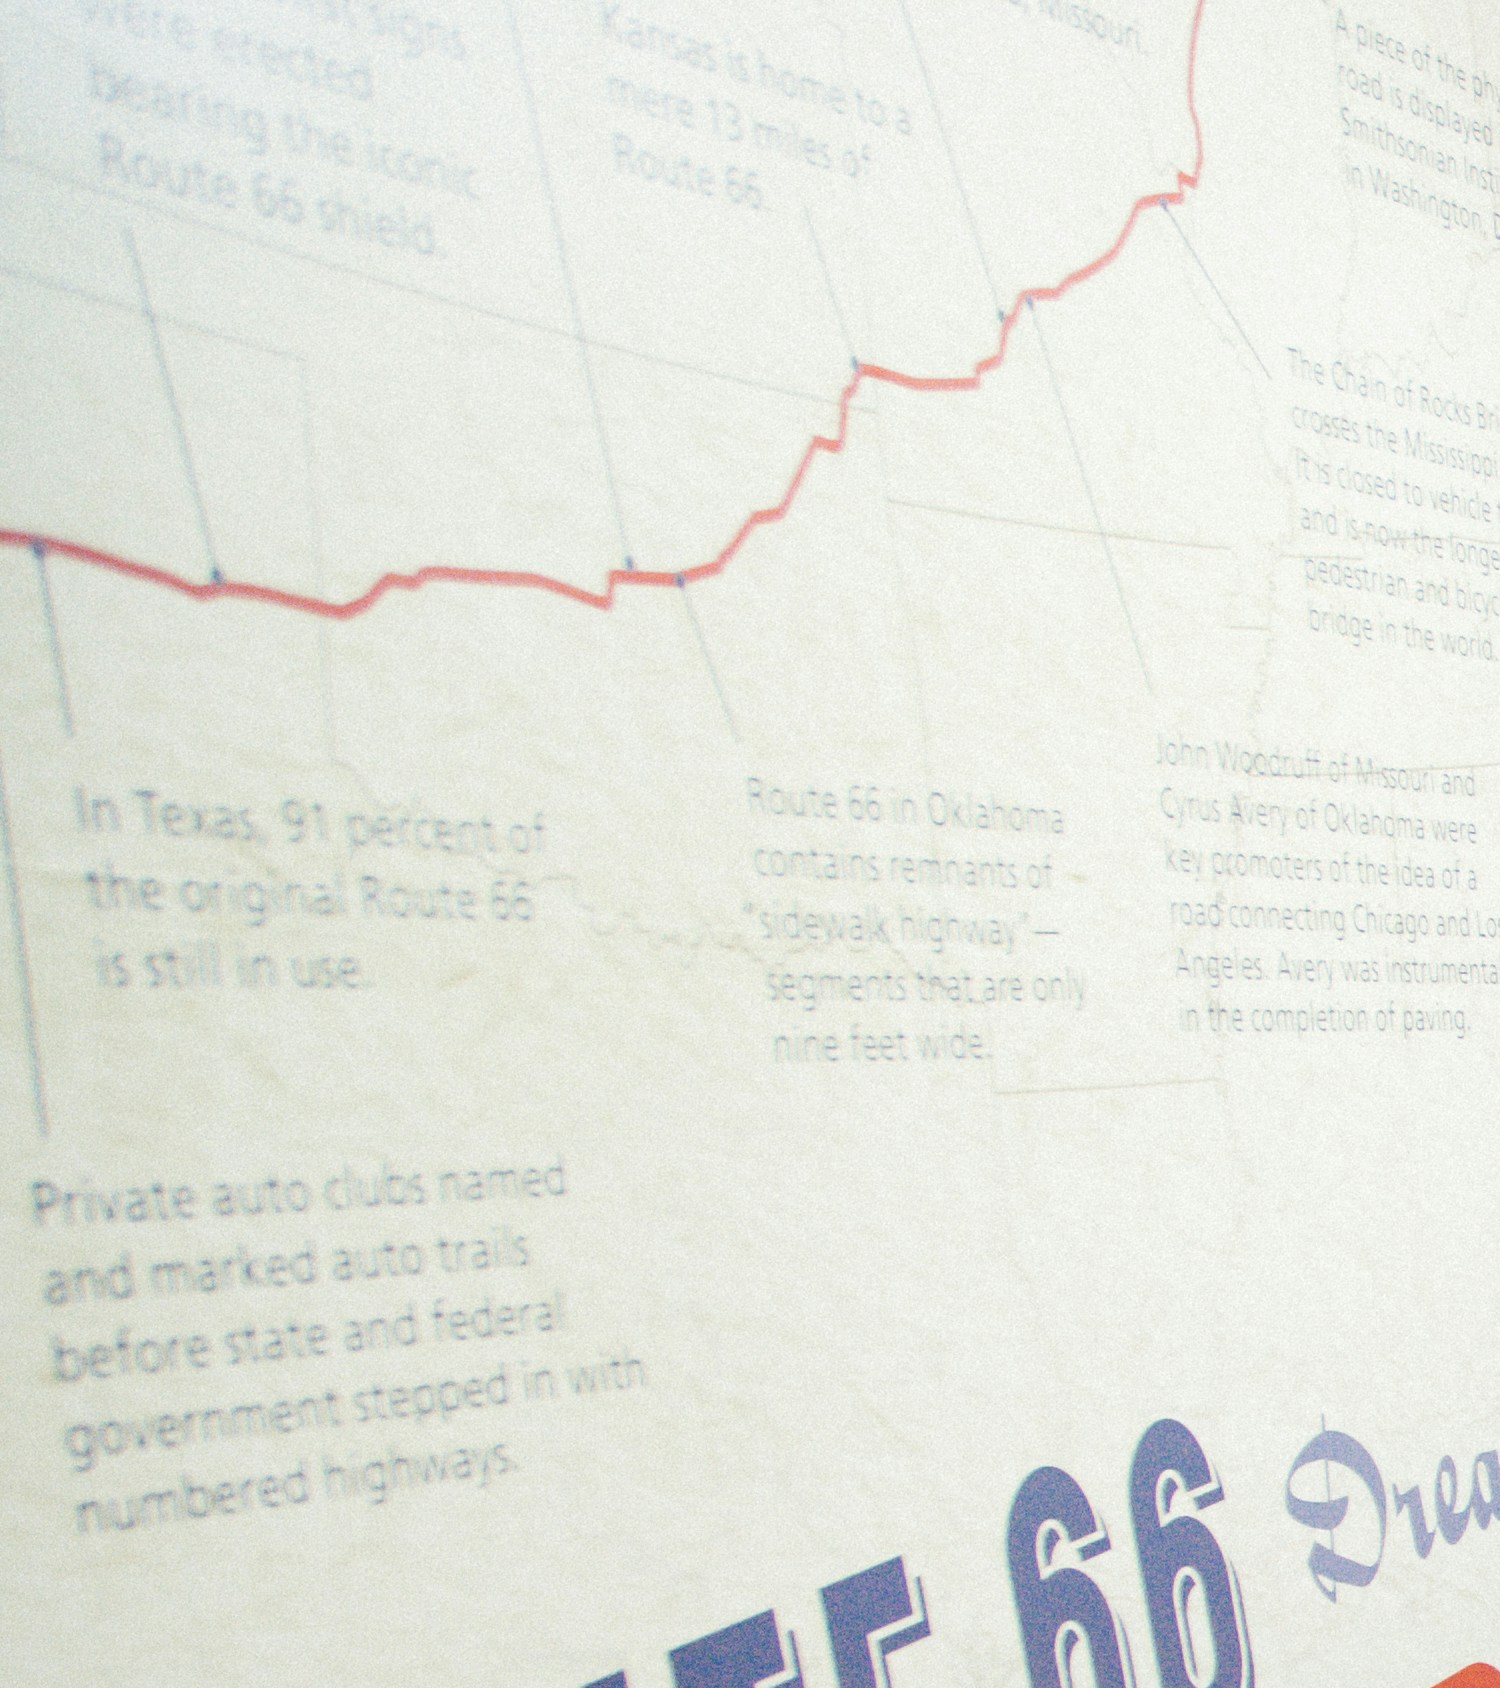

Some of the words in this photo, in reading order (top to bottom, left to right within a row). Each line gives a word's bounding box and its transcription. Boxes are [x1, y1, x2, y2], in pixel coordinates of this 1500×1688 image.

[1335, 8, 1349, 38] A
[1411, 44, 1431, 75] of
[1435, 52, 1468, 92] the
[757, 48, 846, 116] home
[1337, 62, 1384, 101] road
[1408, 86, 1494, 147] displayed
[706, 97, 743, 143] 13
[1339, 105, 1459, 178] Smithsonian
[97, 132, 238, 210] Route
[251, 172, 305, 226] 66
[611, 131, 714, 198] Route
[1286, 345, 1325, 387] The
[1331, 357, 1388, 402] Chain
[1393, 378, 1413, 408] of
[1419, 384, 1472, 427] Rocks
[1291, 404, 1360, 444] crosses
[1365, 421, 1398, 455] the
[1403, 427, 1497, 484] Mississippi
[1301, 506, 1338, 538] and
[1337, 463, 1398, 503] closed
[1429, 486, 1492, 525] vehicle
[1305, 555, 1406, 600] pedestrian
[1413, 575, 1449, 609] and
[1307, 599, 1374, 650] bridge
[1401, 618, 1434, 653] the
[1156, 732, 1208, 768] John
[1442, 767, 1478, 799] and
[73, 785, 122, 836] In
[281, 797, 333, 846] 91
[346, 806, 498, 854] percent
[507, 807, 548, 857] of
[746, 775, 838, 821] Route
[849, 783, 882, 824] 66
[925, 789, 1065, 836] Oklahoma
[1159, 784, 1222, 831] Cyrus
[1228, 792, 1290, 838] Avery
[1323, 800, 1426, 842] Oklahoma
[1431, 820, 1479, 847] were
[754, 847, 881, 884] contains
[890, 854, 1018, 889] remnants
[1025, 852, 1053, 891] of
[1163, 838, 1200, 884] key
[1211, 848, 1324, 884] promoters
[1327, 851, 1351, 885] of
[1355, 855, 1391, 887] the
[1394, 858, 1437, 890] idea
[84, 866, 163, 915] the
[179, 869, 347, 929] original
[360, 873, 479, 922] Route
[490, 878, 537, 924] 66
[1169, 898, 1225, 930] road
[1228, 901, 1348, 944] connecting
[1352, 902, 1430, 946] Chicago
[1436, 907, 1471, 939] and
[96, 942, 131, 989] is
[144, 942, 222, 989] still
[236, 942, 280, 989] in
[765, 970, 907, 1014] segments
[915, 967, 972, 1004] that
[984, 974, 1024, 1003] are
[1031, 966, 1087, 1013] only
[1277, 950, 1334, 992] Avery
[1340, 956, 1382, 985] was
[773, 1024, 840, 1064] nine
[849, 1022, 909, 1064] feet
[1206, 994, 1245, 1034] the
[1249, 999, 1370, 1036] completion
[1374, 999, 1398, 1034] of
[30, 1175, 197, 1228] Private
[211, 1177, 313, 1219] auto
[324, 1157, 428, 1210] clubs
[438, 1153, 568, 1204] named
[43, 1250, 136, 1307] and
[148, 1240, 318, 1293] marked
[331, 1237, 428, 1283] auto
[436, 1224, 531, 1271] trails
[50, 1320, 212, 1385] before
[222, 1320, 331, 1367] state
[343, 1307, 422, 1354] and
[431, 1290, 567, 1345] federal
[62, 1388, 343, 1476] government
[352, 1360, 512, 1426] stepped
[521, 1358, 560, 1402] in
[566, 1347, 649, 1396] with
[74, 1463, 311, 1537] numbered
